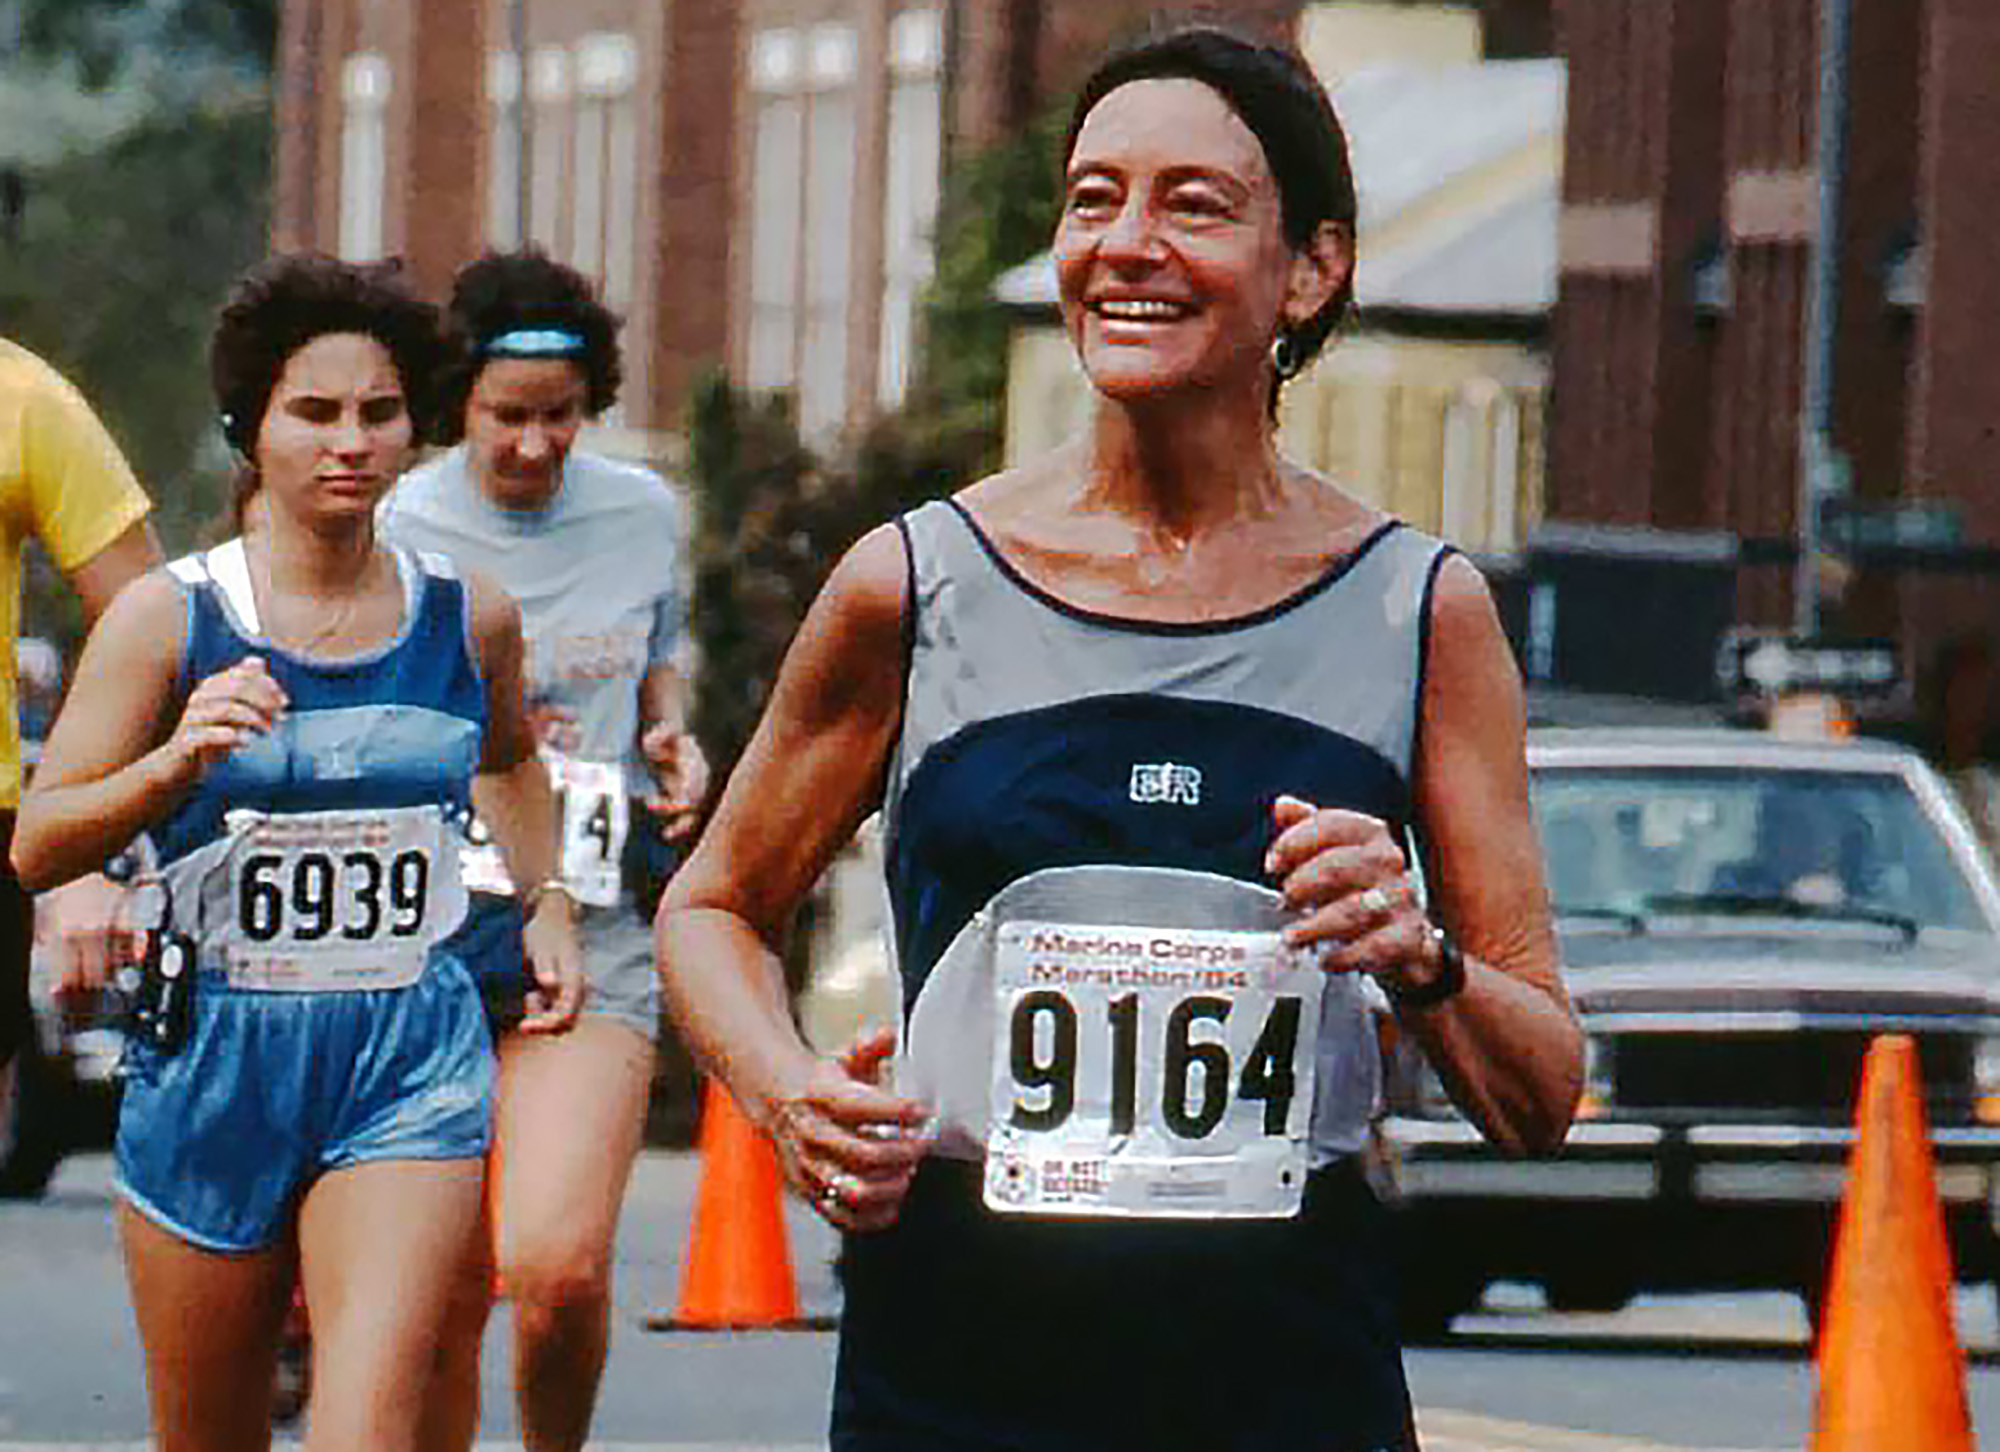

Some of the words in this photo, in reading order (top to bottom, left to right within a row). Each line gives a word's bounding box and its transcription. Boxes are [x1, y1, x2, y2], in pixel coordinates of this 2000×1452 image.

[239, 850, 429, 941] 6939
[1149, 939, 1247, 963] Corps
[1008, 991, 1302, 1139] 9164
